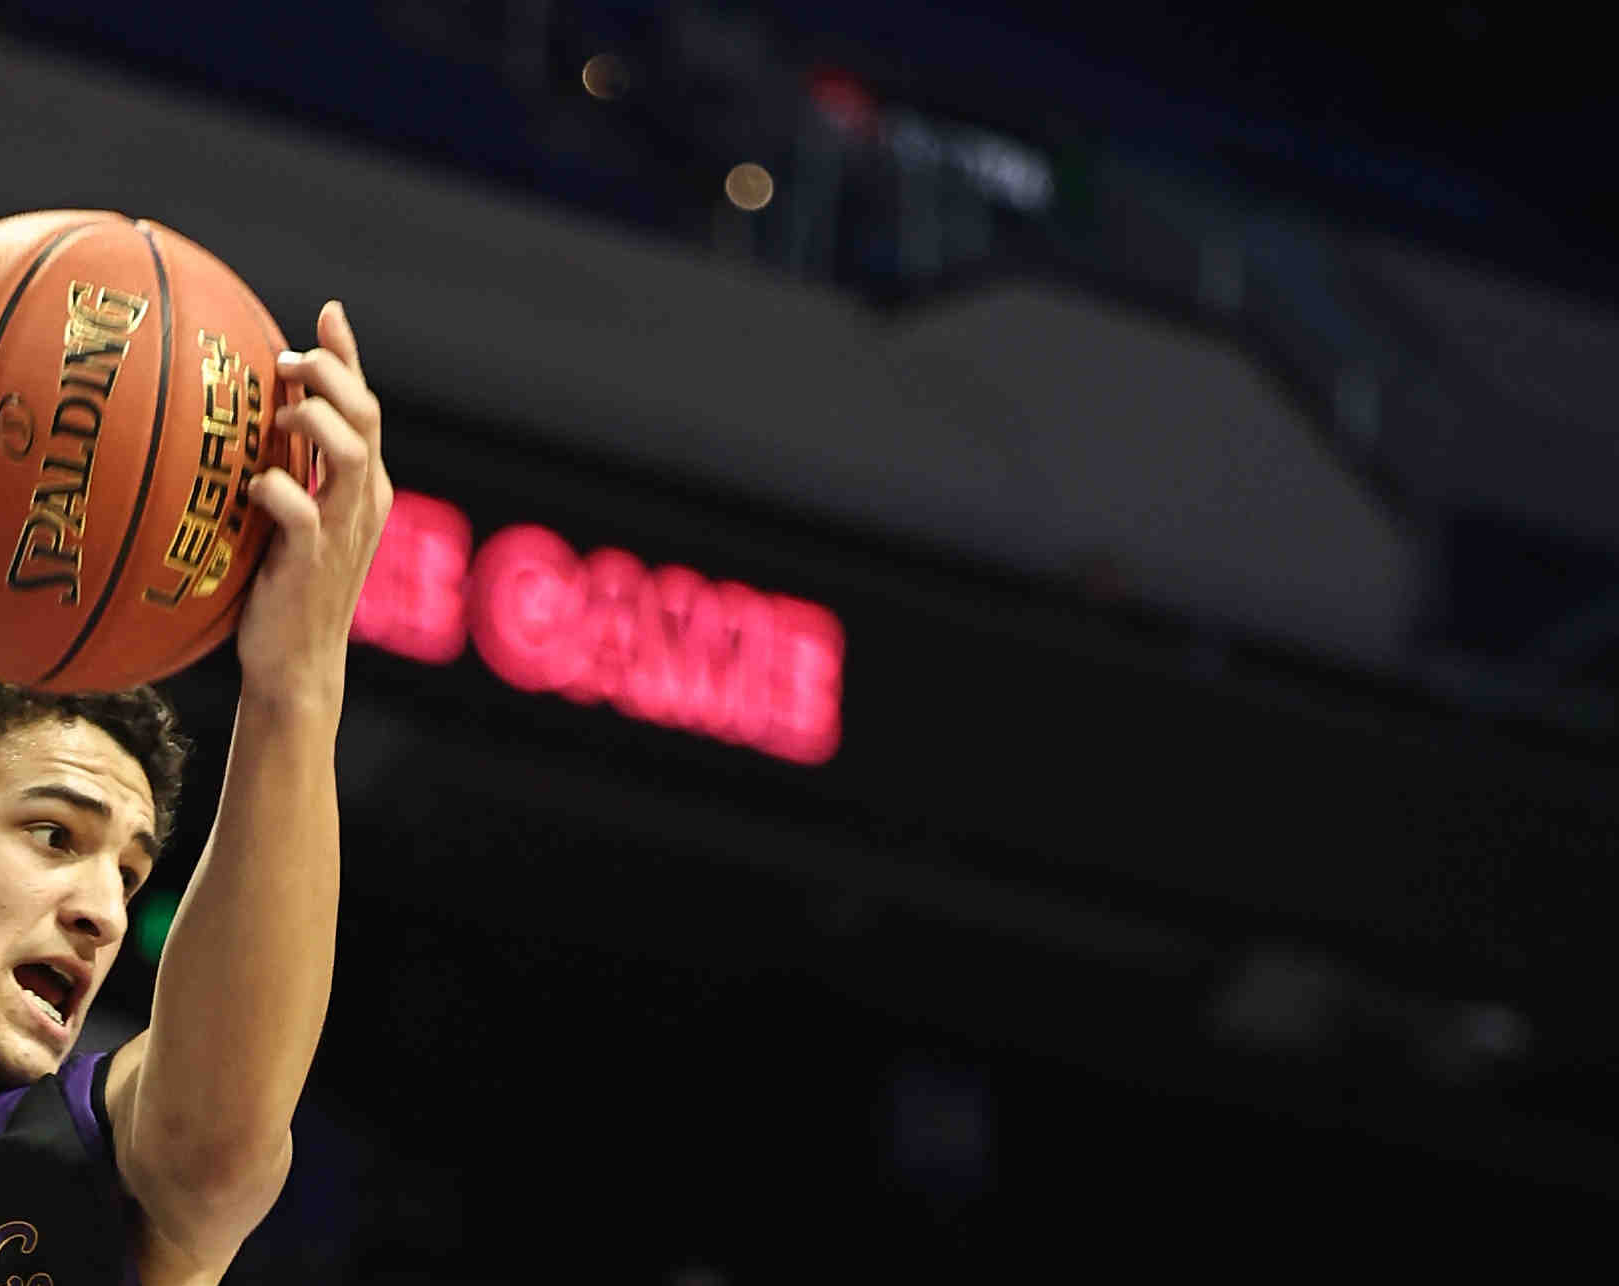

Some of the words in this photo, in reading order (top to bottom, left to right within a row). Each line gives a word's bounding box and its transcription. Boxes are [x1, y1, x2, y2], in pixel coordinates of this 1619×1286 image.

[5, 278, 150, 607] SPALDING
[142, 328, 242, 612] LEGACY
[470, 521, 845, 767] GAME
